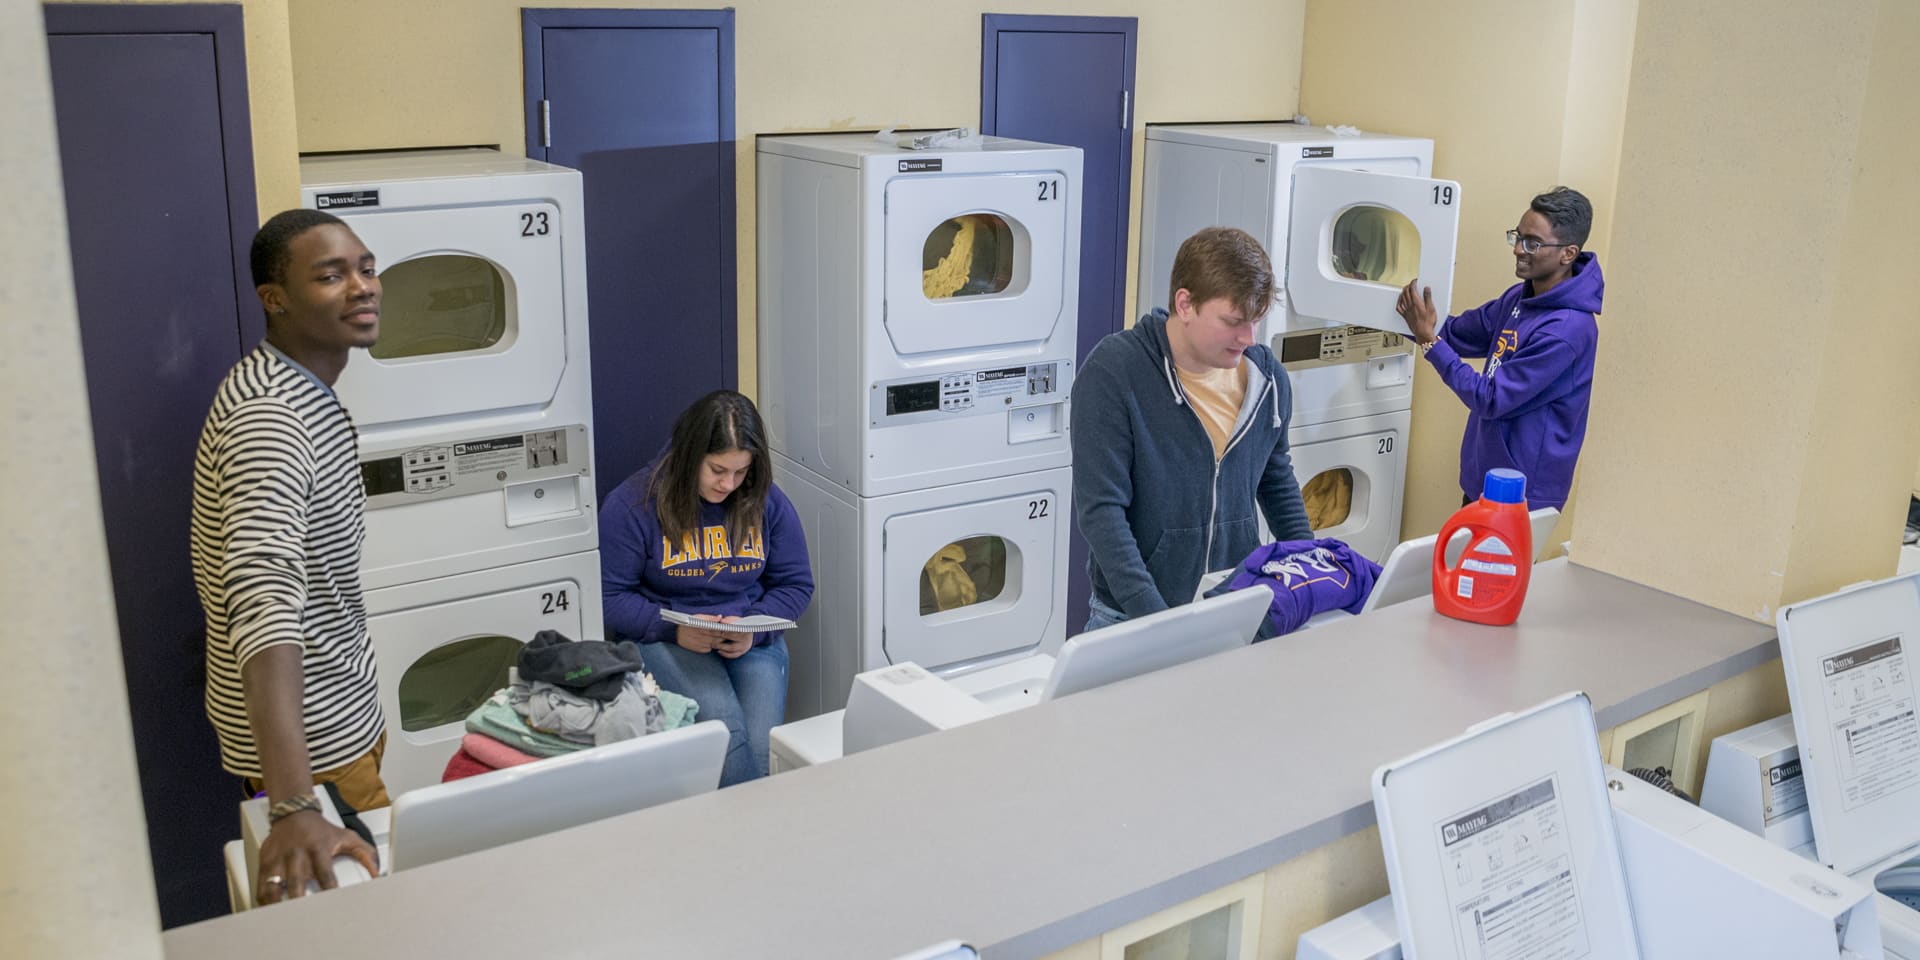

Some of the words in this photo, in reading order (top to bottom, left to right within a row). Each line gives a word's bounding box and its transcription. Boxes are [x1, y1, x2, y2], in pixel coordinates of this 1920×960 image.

[1038, 180, 1057, 201] 21
[1433, 185, 1452, 206] 19
[521, 211, 549, 237] 23
[1378, 437, 1393, 455] 20
[1028, 498, 1048, 519] 22
[541, 590, 569, 615] 24
[1456, 814, 1489, 835] MAYTAG
